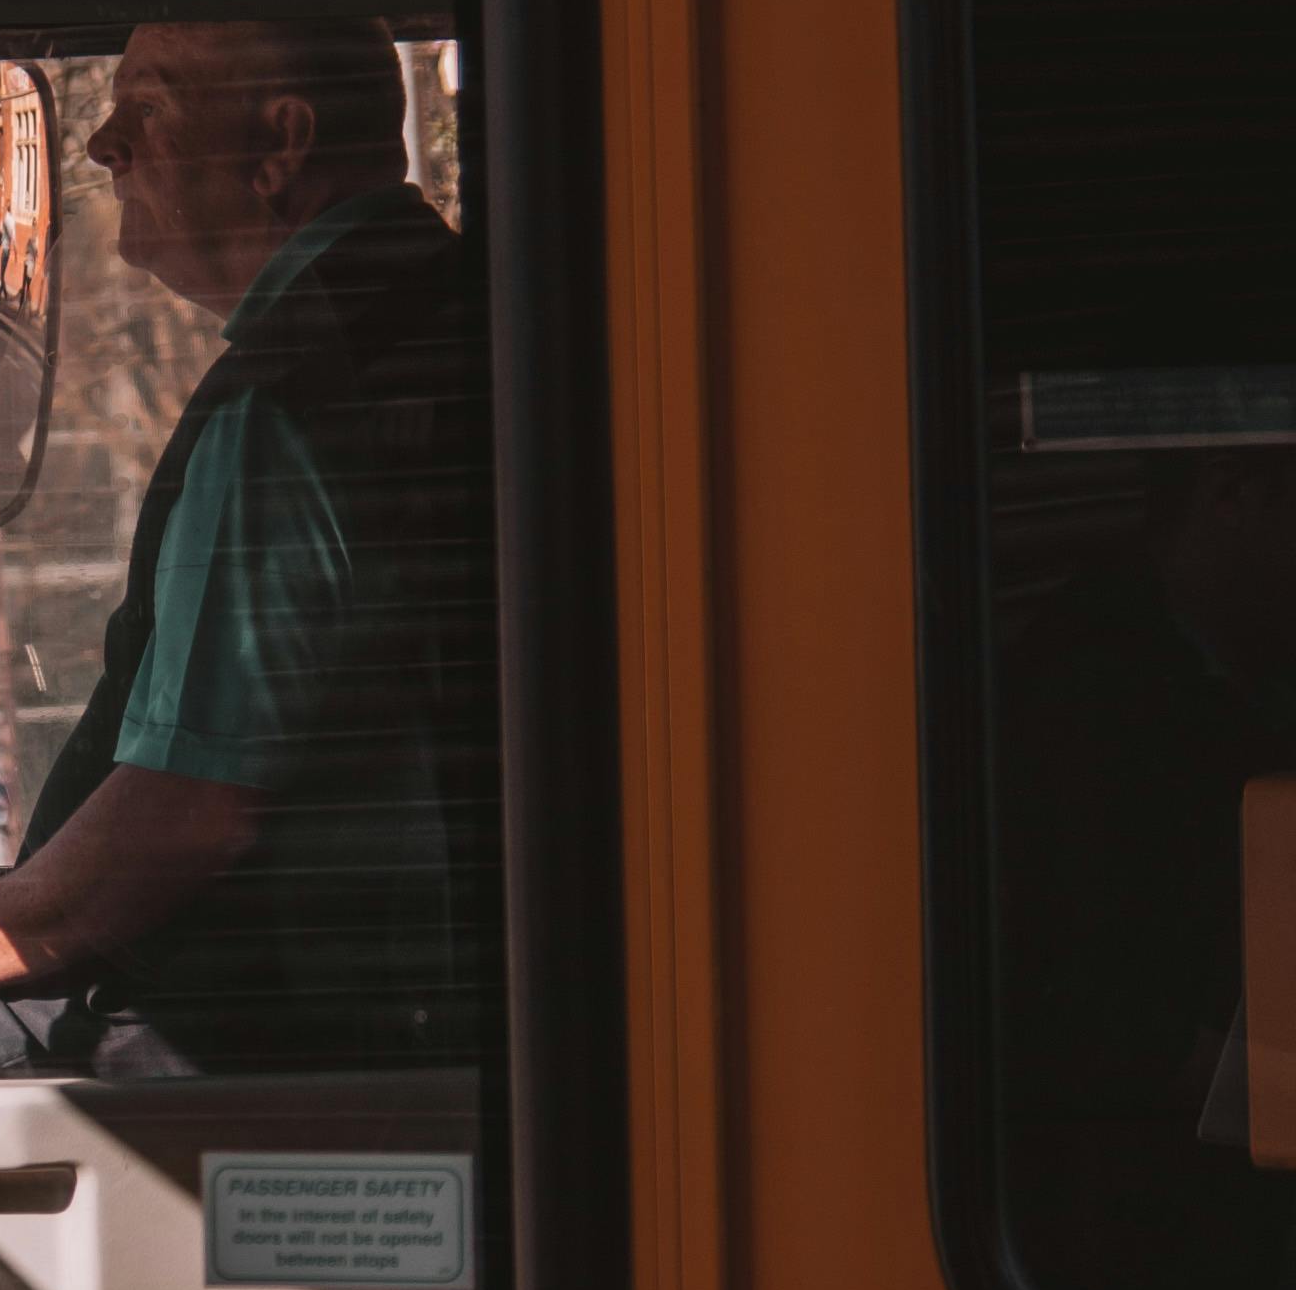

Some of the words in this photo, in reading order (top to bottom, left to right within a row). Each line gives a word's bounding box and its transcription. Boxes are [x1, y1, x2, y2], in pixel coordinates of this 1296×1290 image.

[228, 1178, 358, 1197] PASSENGER
[363, 1179, 446, 1197] SAFETY
[238, 1208, 255, 1223] In
[259, 1208, 287, 1223] the
[292, 1208, 356, 1224] interest
[361, 1208, 379, 1224] of
[383, 1209, 434, 1228] safety
[232, 1230, 282, 1245] doors
[287, 1230, 315, 1245] will
[320, 1231, 348, 1245] not
[353, 1231, 374, 1246] be
[378, 1231, 443, 1248] opened
[275, 1252, 347, 1268] between
[353, 1253, 400, 1269] stops
